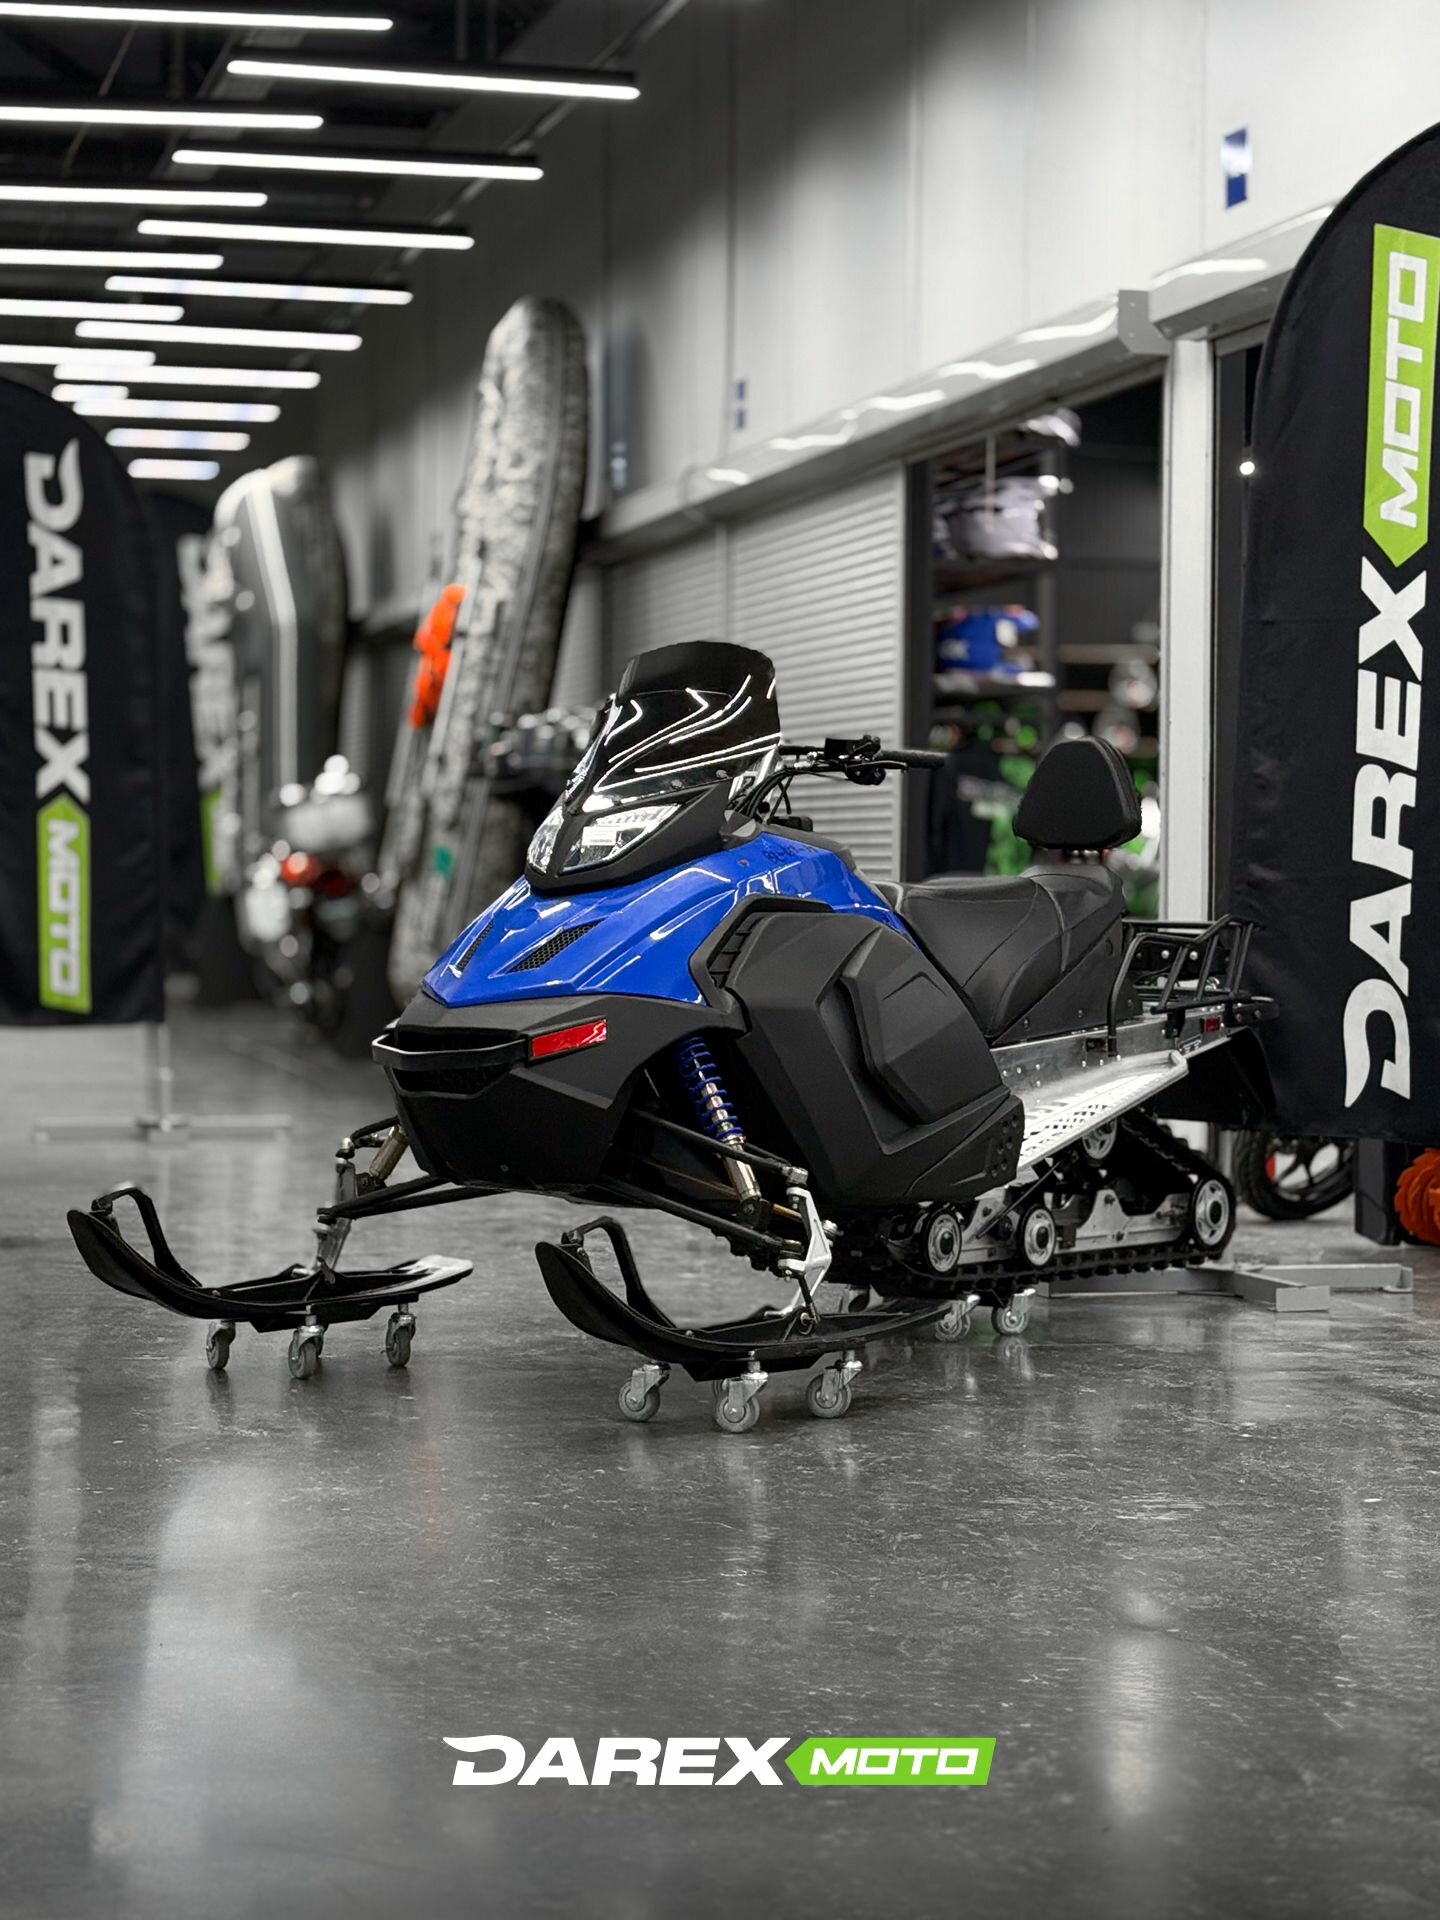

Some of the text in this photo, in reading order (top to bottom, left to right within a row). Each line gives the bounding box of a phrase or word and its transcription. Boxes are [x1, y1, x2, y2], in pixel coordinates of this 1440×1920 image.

[24, 439, 90, 998] DAREX MOTO
[1342, 250, 1429, 1109] DAREX MOTO
